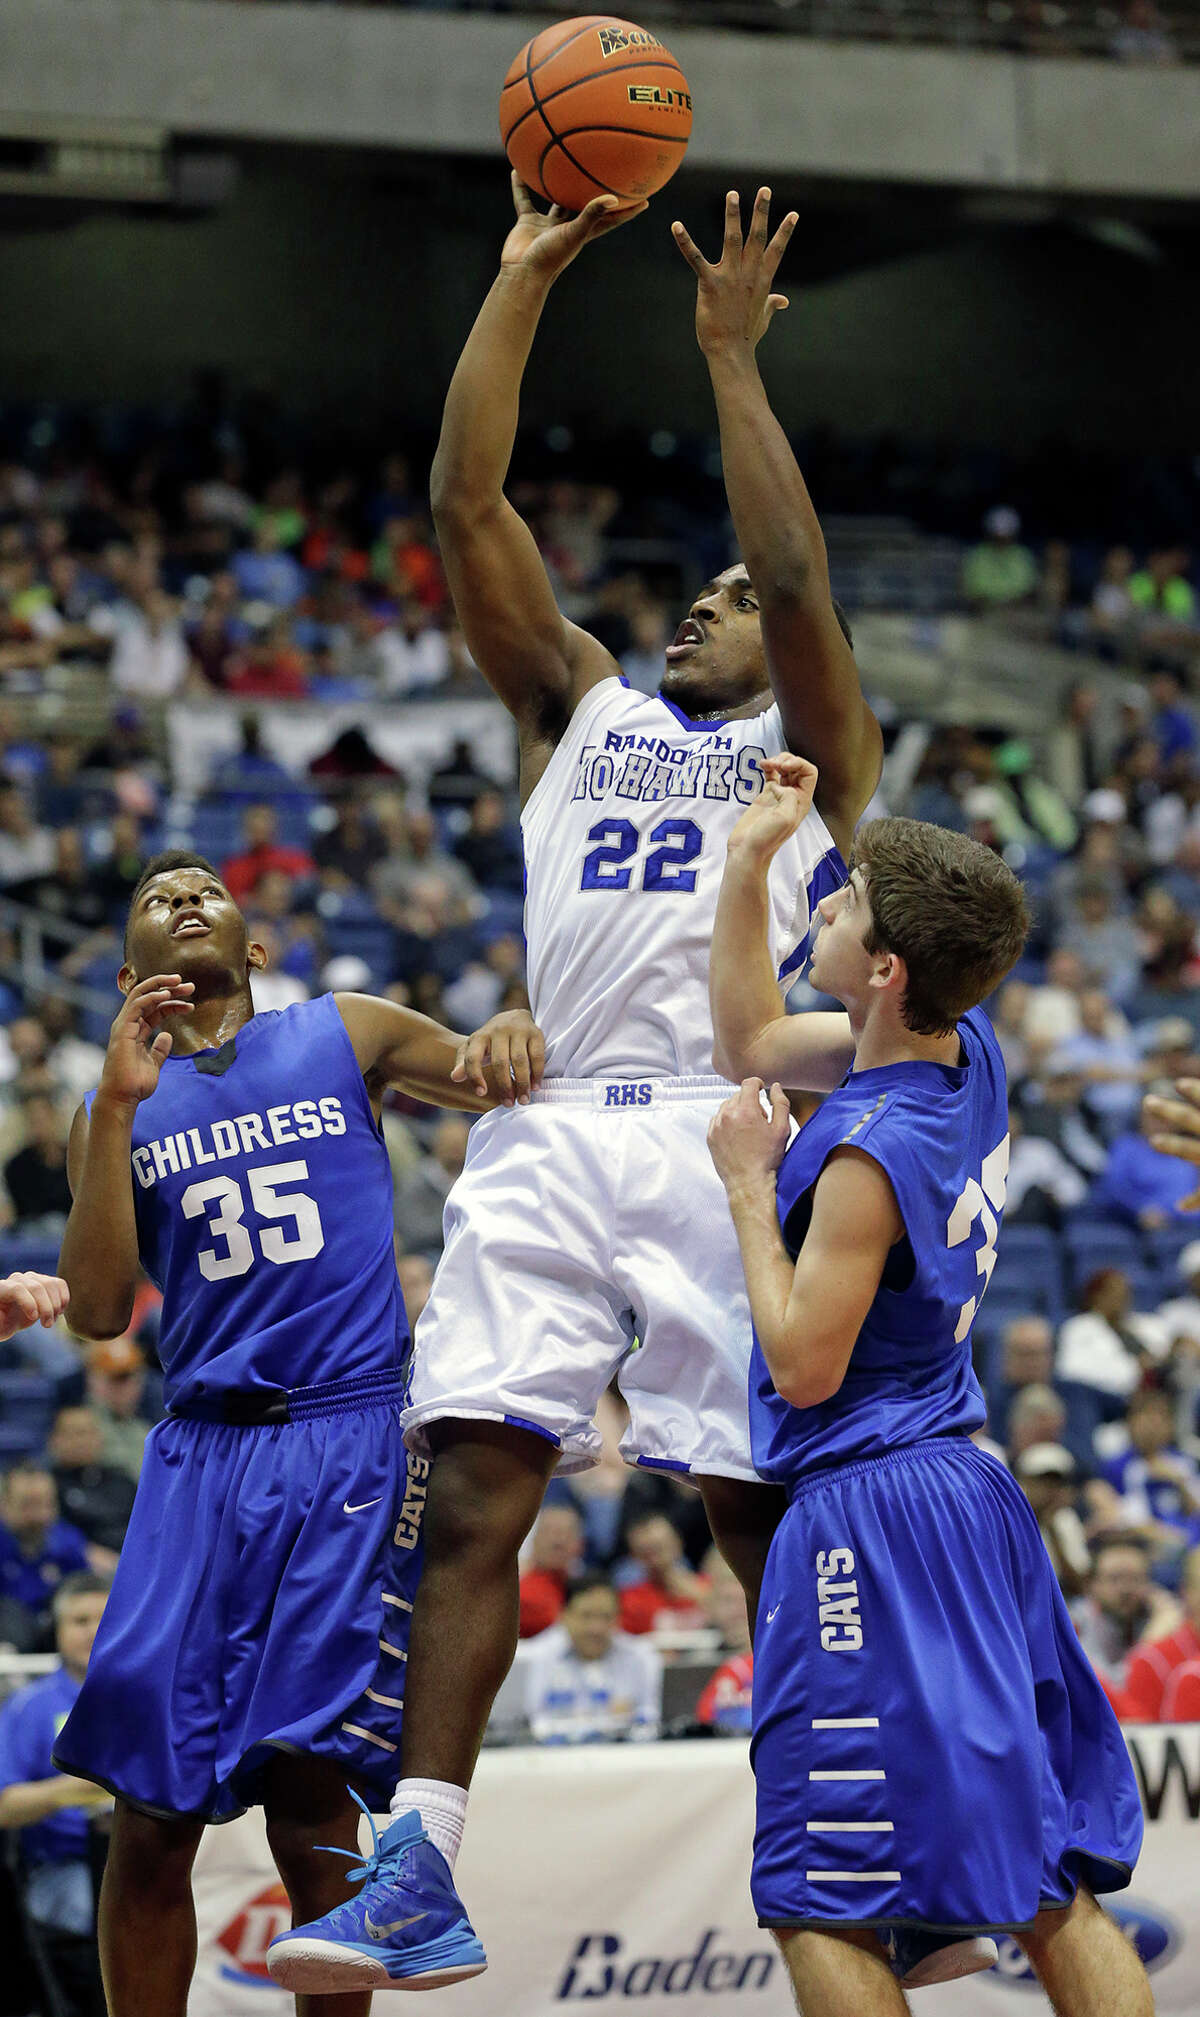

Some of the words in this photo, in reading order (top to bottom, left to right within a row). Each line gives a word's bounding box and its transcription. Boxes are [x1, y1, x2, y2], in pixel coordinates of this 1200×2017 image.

[627, 85, 692, 112] ELITE
[578, 817, 705, 893] 22
[604, 1083, 652, 1106] RHS
[131, 1097, 347, 1189] CHILDRESS
[181, 1160, 325, 1282] 35
[394, 1451, 431, 1550] CATS
[816, 1547, 864, 1652] CATS
[558, 1927, 775, 1999] Baden
